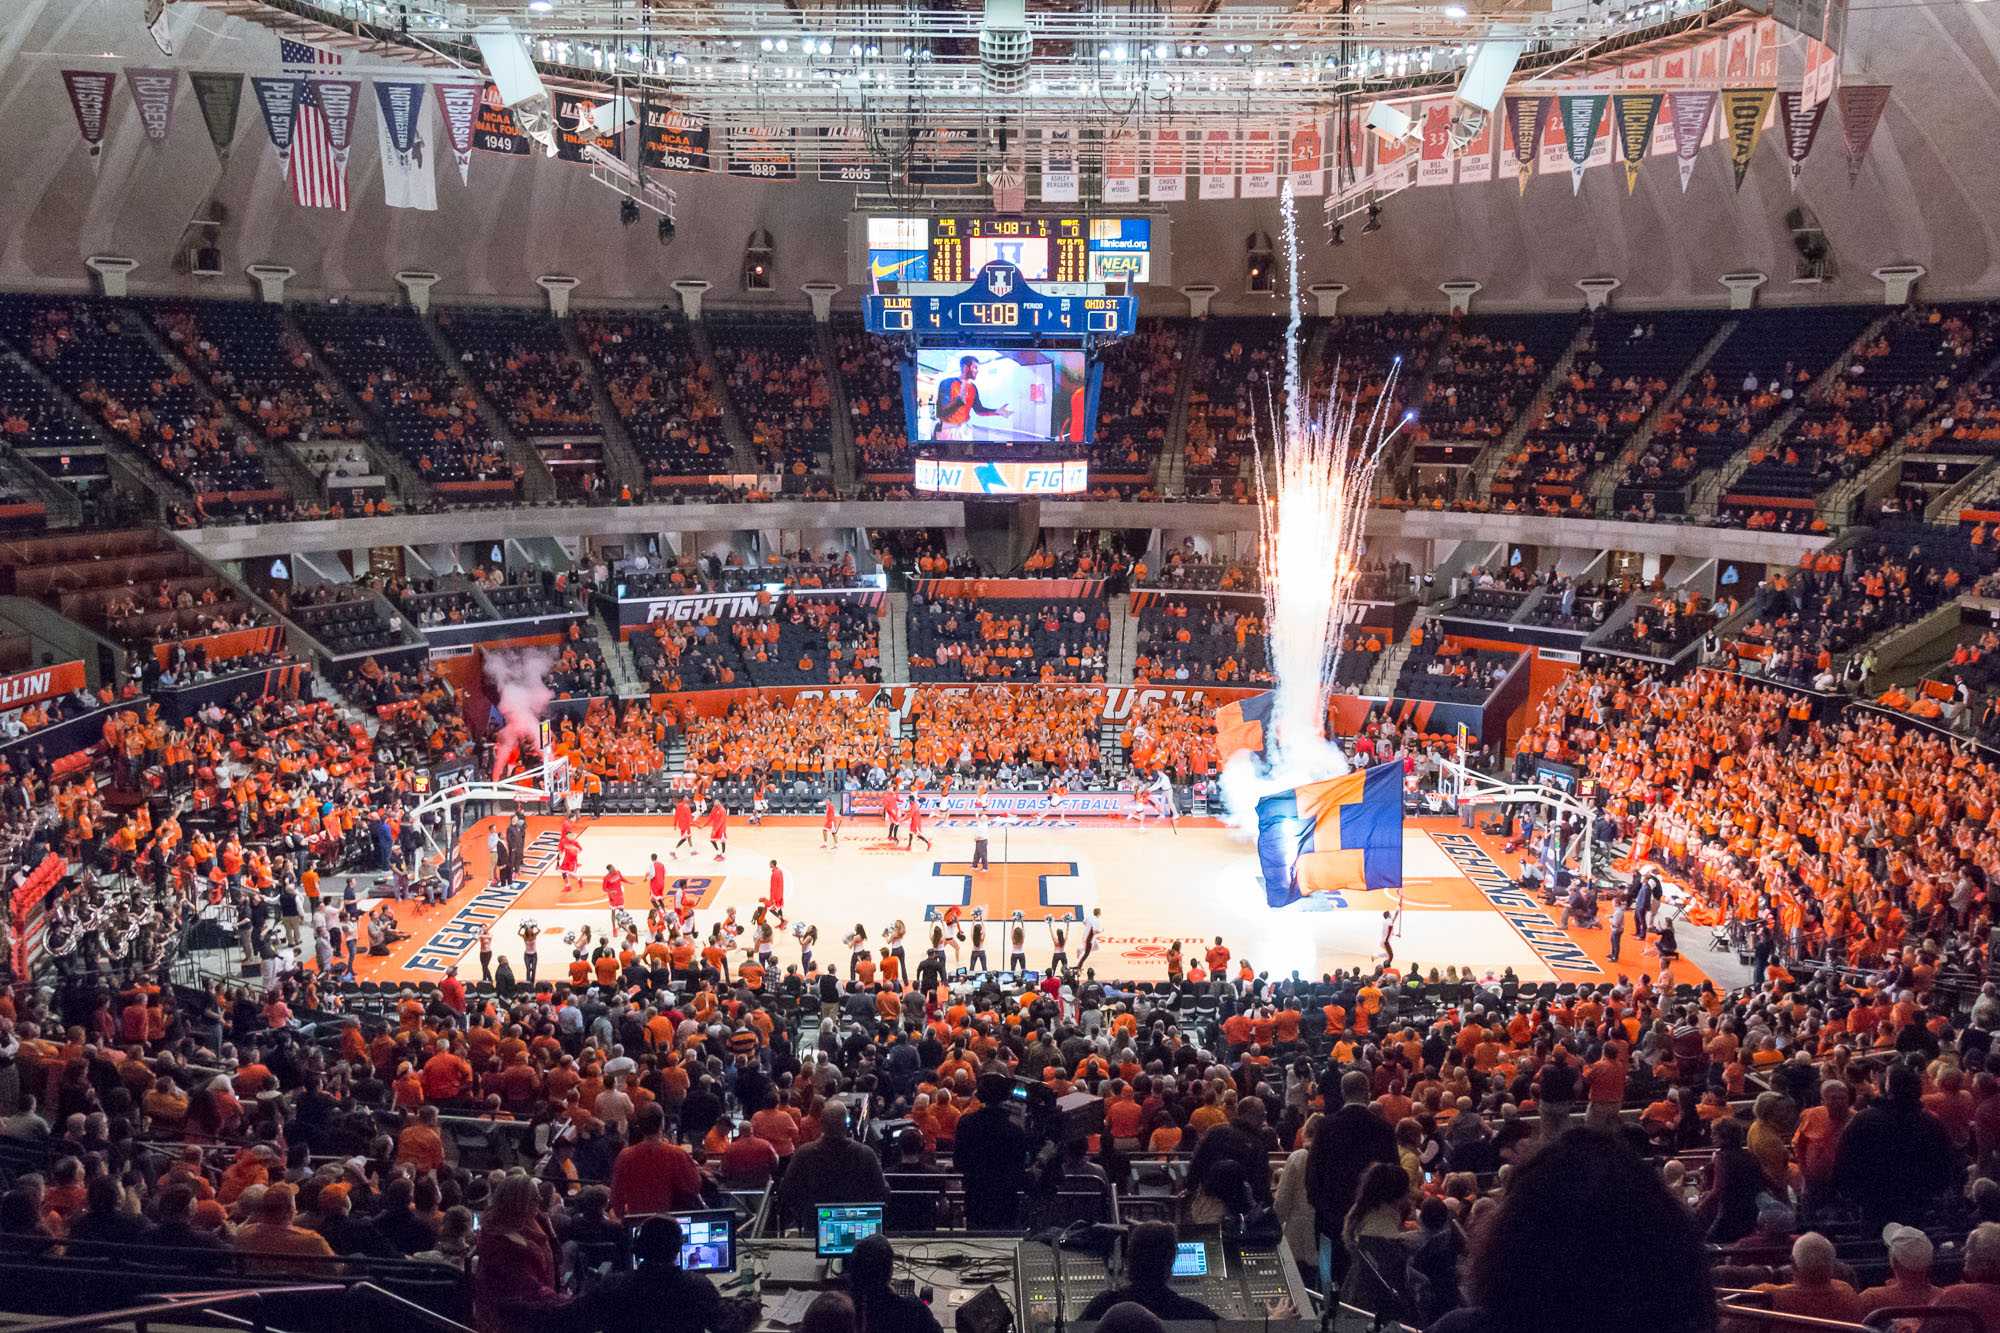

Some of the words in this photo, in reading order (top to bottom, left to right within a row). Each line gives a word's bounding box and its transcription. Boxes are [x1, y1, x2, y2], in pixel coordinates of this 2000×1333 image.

[72, 76, 106, 139] WISCONSIN
[134, 76, 172, 138] RUTGERS
[260, 81, 295, 115] PENN
[318, 84, 352, 116] OHIO
[269, 116, 290, 147] STATE
[328, 116, 348, 146] STATE
[388, 87, 411, 148] NORTHWESTERN
[443, 88, 475, 149] NEBRASKA
[483, 112, 510, 124] NCAA
[1518, 100, 1540, 160] MINNESOTA
[1571, 99, 1594, 136] MICHIGAN
[1622, 98, 1654, 160] MICHIGAN
[1676, 95, 1711, 156] MARYLAND
[1731, 97, 1764, 157] IOWA
[485, 135, 512, 151] 1949
[662, 134, 690, 145] NCAA
[1298, 145, 1314, 159] 25
[1429, 133, 1445, 146] 33
[1572, 137, 1587, 160] STATE
[1103, 257, 1140, 270] NEAL
[883, 298, 912, 309] ILLINI
[973, 303, 1019, 325] 4:08
[1033, 310, 1039, 326] 1
[1085, 299, 1104, 310] OHIO
[1105, 299, 1120, 310] ST.
[901, 312, 911, 329] 0
[930, 313, 940, 328] 4
[1060, 314, 1070, 328] 4
[1105, 312, 1117, 329] 0
[0, 671, 51, 705] LLINI
[1431, 831, 1544, 910] FIGHTING
[1503, 911, 1605, 975] ILLINI
